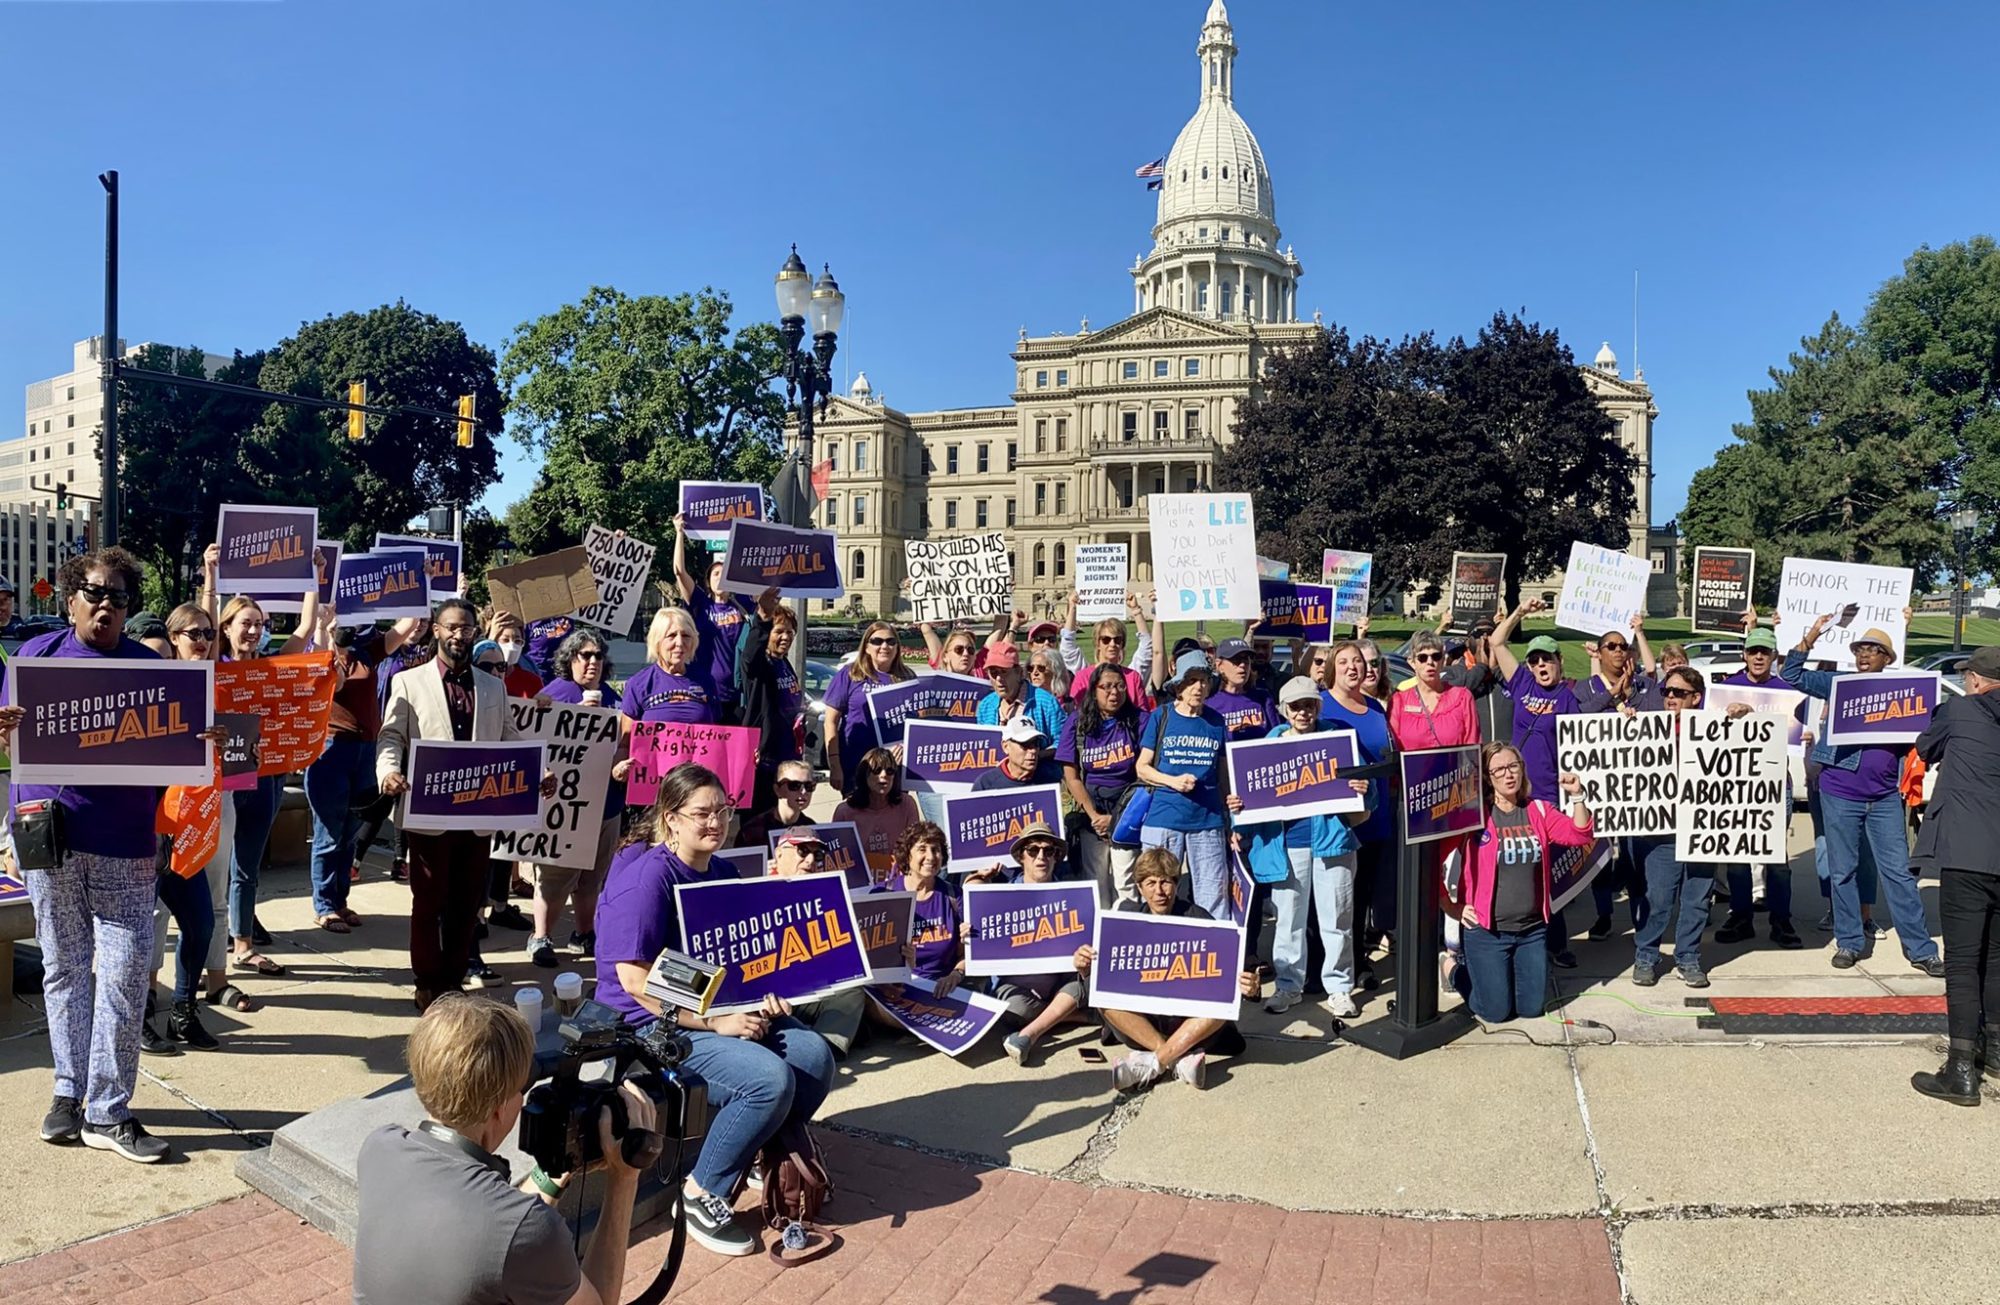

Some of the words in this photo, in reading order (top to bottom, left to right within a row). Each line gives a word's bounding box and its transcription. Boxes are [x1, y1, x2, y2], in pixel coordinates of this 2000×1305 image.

[690, 494, 747, 510] REPRODUCTIVE
[690, 506, 725, 518] FREEDOM
[724, 500, 755, 520] ALL
[1209, 501, 1247, 526] LIE
[1169, 520, 1178, 528] IS
[1187, 520, 1195, 528] A
[229, 524, 294, 549] REPRODUCTIVE
[588, 529, 652, 563] 750,000+
[907, 540, 938, 559] GOD
[938, 537, 980, 559] KILLED
[982, 533, 1005, 553] HIS
[1171, 536, 1196, 549] YOU
[228, 541, 269, 560] FREEDOM
[267, 535, 304, 564] ALL
[742, 544, 810, 557] REPRODUCTIVE
[1076, 556, 1108, 564] RIGHTS
[1081, 546, 1122, 554] WOMEN'S
[1168, 554, 1200, 568] CARE
[1216, 551, 1227, 564] IF
[741, 555, 781, 567] FREEDOM
[779, 552, 826, 574] ALL
[910, 560, 944, 578] ONLY
[948, 557, 981, 578] SON,
[985, 554, 1007, 574] HE
[340, 581, 381, 598] FREEDOM
[383, 570, 420, 594] ALL
[912, 578, 962, 597] CANNOT
[965, 575, 1012, 595] CHOOSE
[1084, 574, 1118, 582] RIGHTS!
[1164, 567, 1237, 589] WOMEN
[1456, 583, 1496, 592] PROTECT
[1699, 580, 1742, 590] PROTECT
[1788, 571, 1848, 591] HONOR
[1866, 578, 1902, 596] THE
[603, 581, 627, 606] US
[1179, 588, 1229, 612] DIE
[1261, 595, 1319, 609] PRODUCTIVE
[1455, 599, 1484, 609] LIVES!
[1456, 591, 1497, 600] WOMEN'S
[1698, 589, 1746, 600] WOMEN'S
[1698, 597, 1729, 608] LIVES!
[578, 603, 619, 626] VOTE
[913, 598, 929, 622] IF
[931, 597, 943, 620] I
[946, 595, 979, 619] HAVE
[979, 595, 1011, 615] ONE
[1266, 605, 1292, 617] EDOM
[1290, 605, 1329, 625] ALL
[1786, 597, 1821, 616] WILL
[1865, 605, 1896, 623] THE
[36, 686, 166, 720] REPRODUCTIVE
[1842, 703, 1887, 719] FREEDOM
[1884, 695, 1927, 721] ALL
[1843, 687, 1916, 710] REPRODUCTIVE
[36, 711, 116, 737] FREEDOM
[87, 734, 106, 744] FOR
[115, 702, 189, 743] ALL
[554, 709, 618, 743] RFFA
[1559, 713, 1673, 747] MICHIGAN
[1690, 716, 1734, 742] Let
[236, 735, 244, 747] is
[650, 736, 709, 756] Rights
[917, 739, 990, 755] REPRODUCTIVE
[223, 750, 247, 762] Care.
[547, 743, 589, 765] THE
[916, 751, 961, 765] FREEDOM
[959, 748, 1000, 770] ALL
[1107, 744, 1135, 766] ALL
[1246, 749, 1328, 780] REPRODUCTIVE
[1560, 743, 1674, 773] COALITION
[425, 760, 517, 785] REPRODUCTIVE
[1247, 769, 1298, 793] FREEDOM
[1409, 763, 1470, 800] REPRODUCTIVE
[424, 779, 481, 796] FREEDOM
[477, 770, 528, 800] ALL
[558, 769, 580, 801] 8
[1409, 787, 1449, 815] FREEDOM
[1447, 773, 1478, 813] ALL
[1606, 772, 1679, 802] REPRO
[1680, 779, 1783, 806] ABORTION
[960, 801, 1034, 830] REPRODUCTIVE
[1592, 804, 1677, 834] ERATION
[1693, 808, 1775, 831] RIGHTS
[961, 821, 1006, 843] FREEDOM
[1496, 824, 1533, 838] OTE
[1498, 835, 1540, 850] OTE
[1688, 833, 1731, 856] FOR
[1734, 833, 1773, 856] ALL
[981, 899, 1068, 928] REPRODUCTIVE
[692, 898, 824, 953] REPRODUCTIVE
[920, 924, 952, 943] ALL
[981, 920, 1035, 940] FREEDOM
[1034, 909, 1085, 943] ALL
[749, 960, 769, 976] FOR
[778, 909, 852, 971] ALL
[1111, 939, 1207, 959] REPRODUCTIVE
[1110, 955, 1169, 972] FREEDOM
[1167, 951, 1223, 981] ALL
